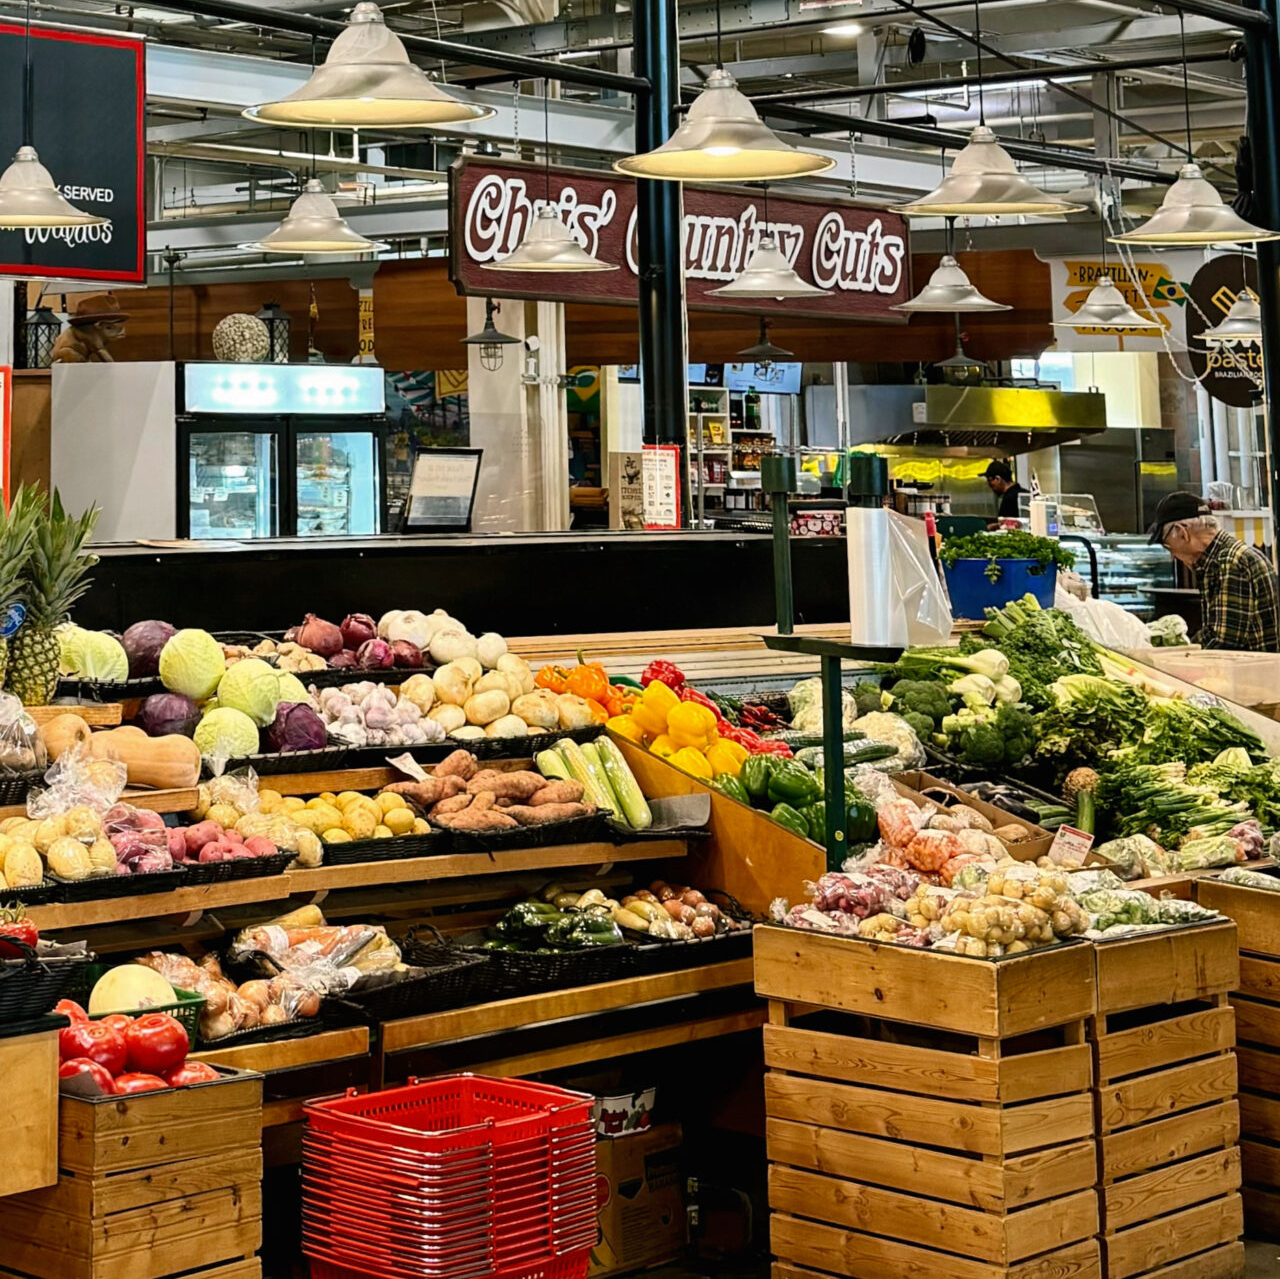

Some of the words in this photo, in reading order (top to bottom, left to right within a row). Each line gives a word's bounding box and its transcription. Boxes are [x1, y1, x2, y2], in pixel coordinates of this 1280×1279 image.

[63, 185, 114, 203] SERVED
[626, 204, 804, 281] unty
[812, 211, 905, 295] Cuts
